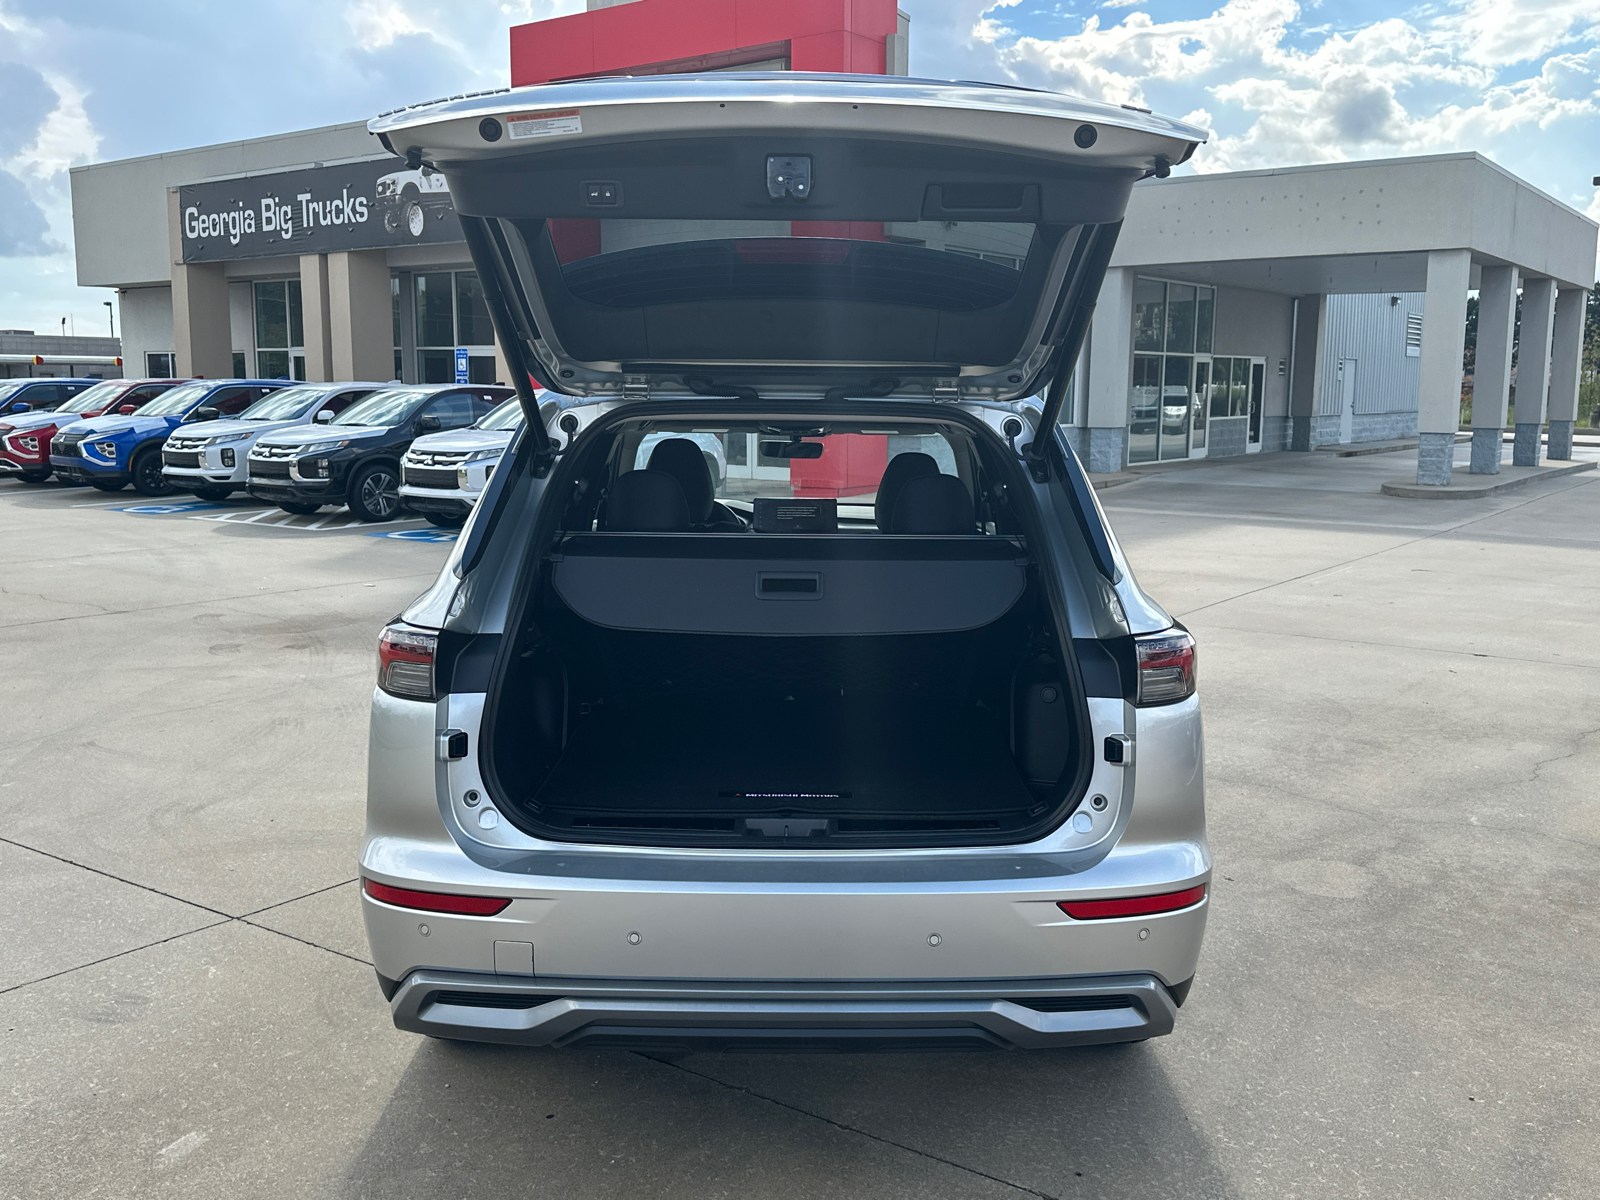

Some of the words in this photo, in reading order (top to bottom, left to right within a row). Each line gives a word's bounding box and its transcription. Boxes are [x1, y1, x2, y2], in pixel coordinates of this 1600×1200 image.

[184, 201, 256, 245] Georgia
[260, 196, 293, 240] Big
[297, 188, 369, 228] Trucks
